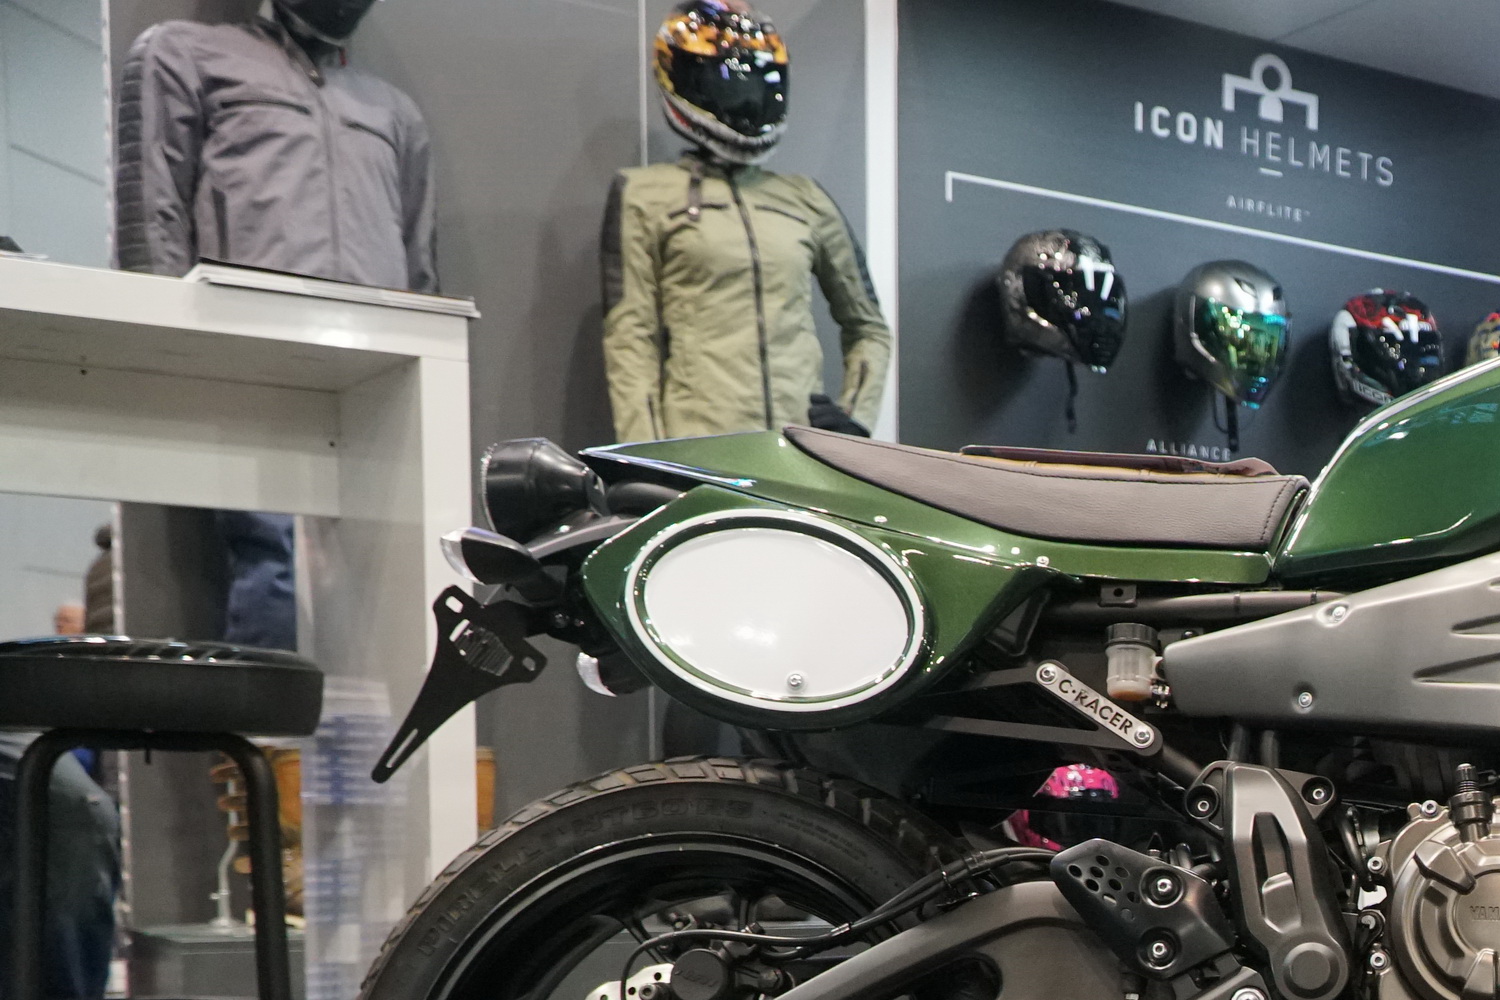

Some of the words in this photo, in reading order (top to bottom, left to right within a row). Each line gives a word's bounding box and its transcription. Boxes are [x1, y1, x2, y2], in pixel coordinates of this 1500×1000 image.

[1134, 101, 1223, 149] ICON
[1241, 126, 1394, 186] HELMETS
[1146, 437, 1230, 462] ALLIANCE
